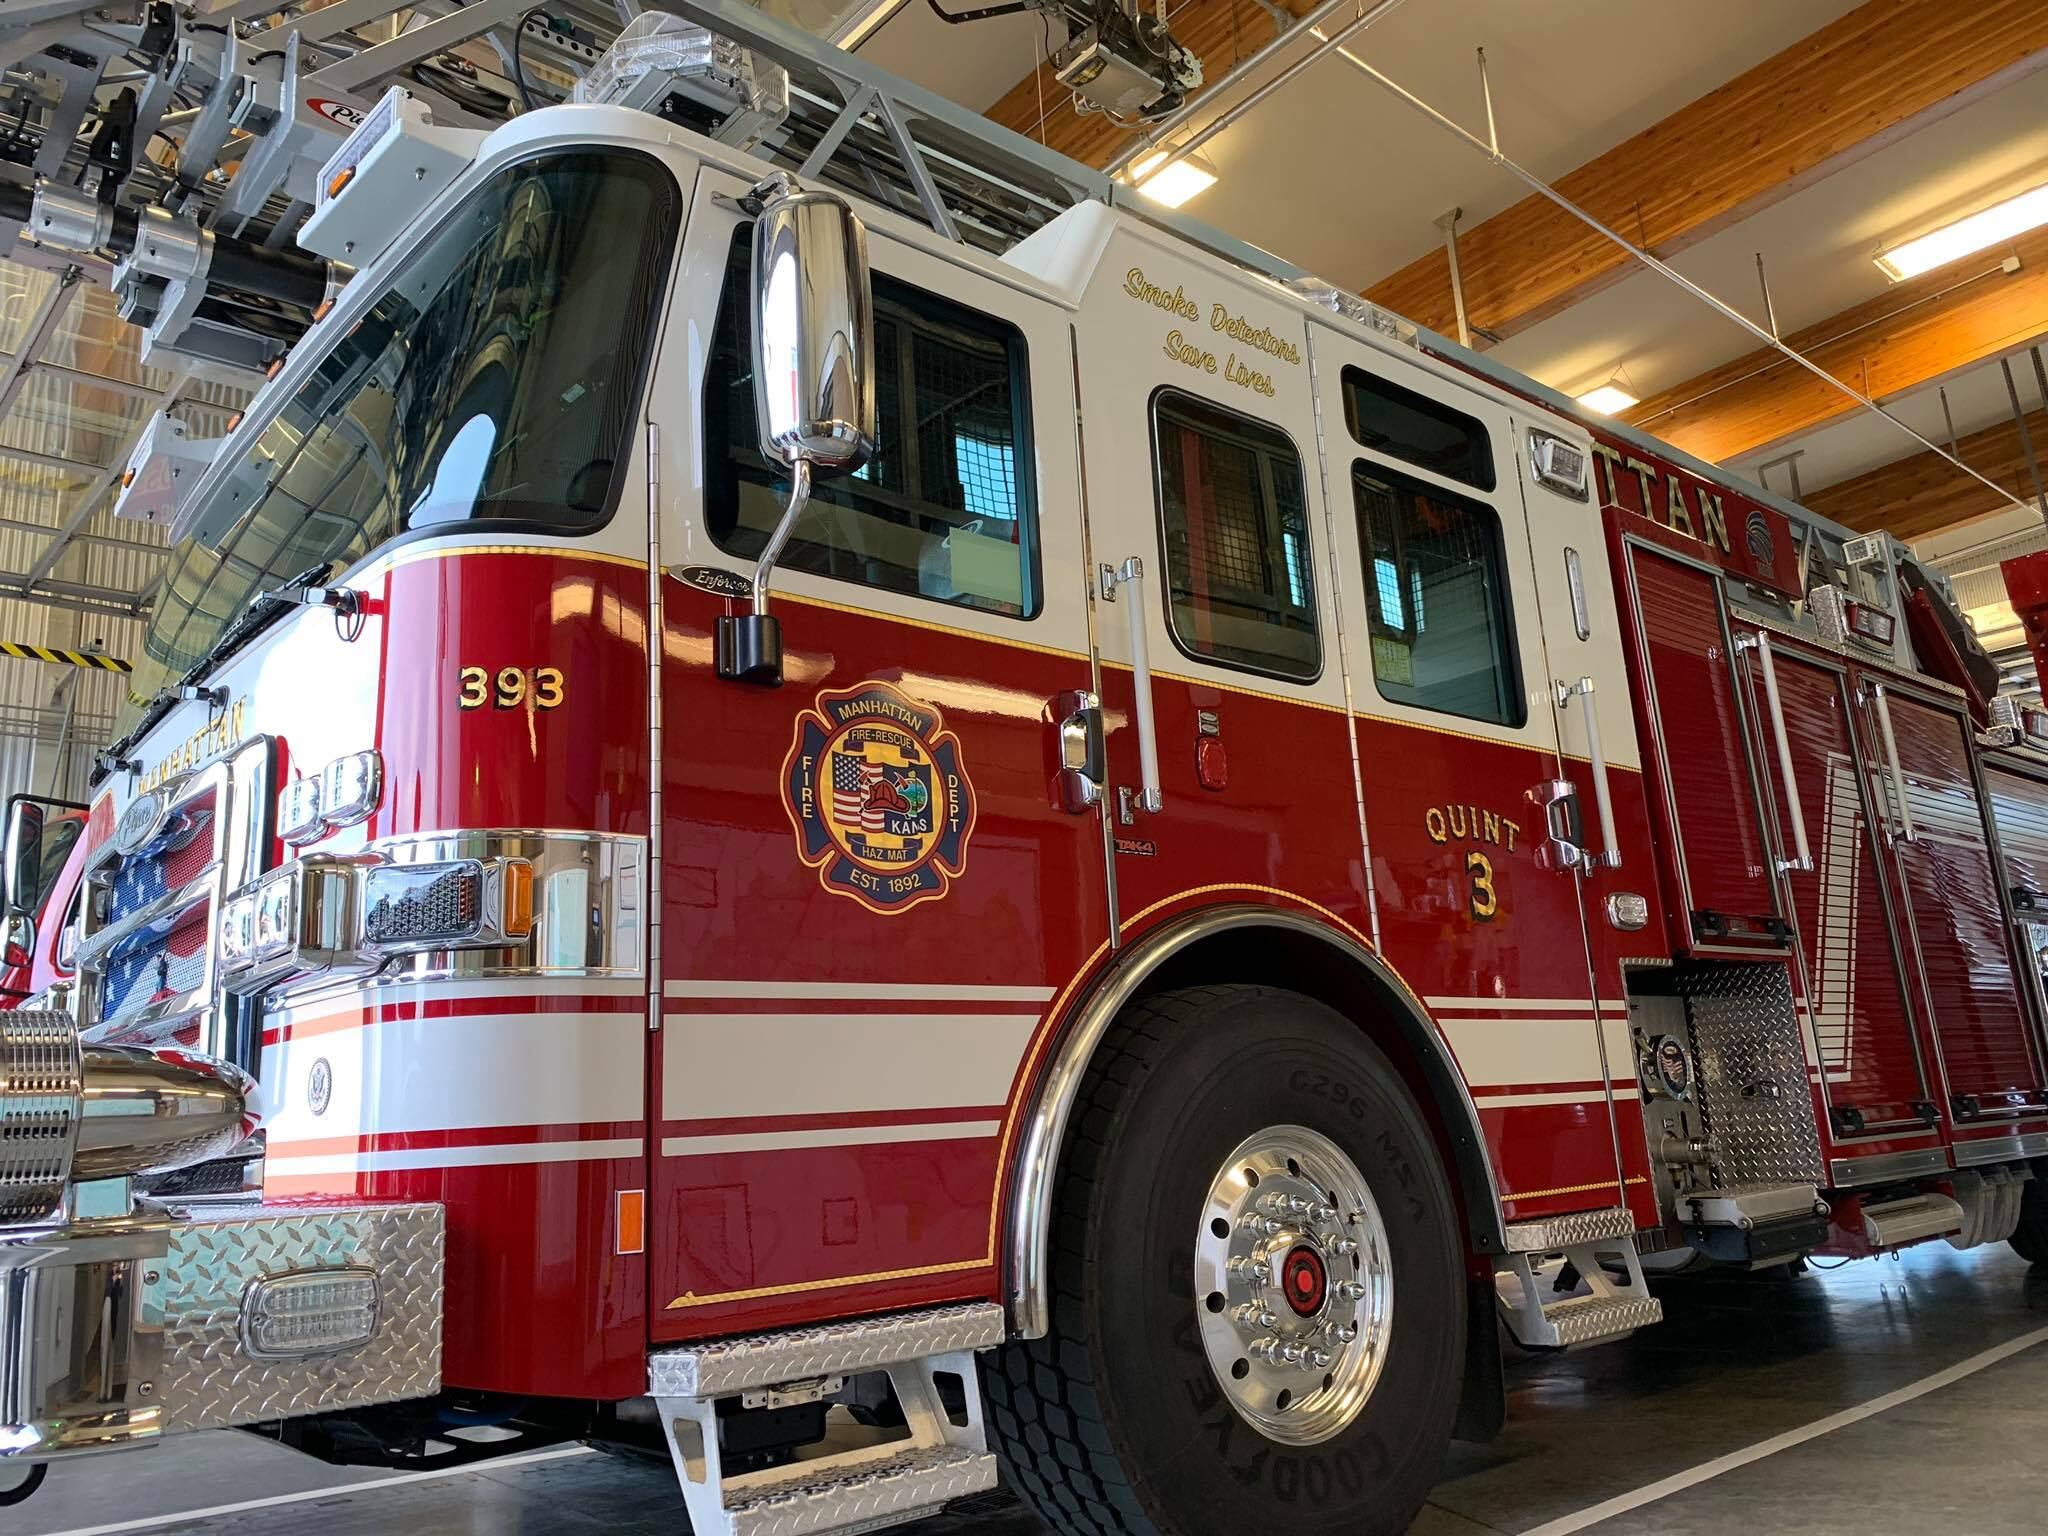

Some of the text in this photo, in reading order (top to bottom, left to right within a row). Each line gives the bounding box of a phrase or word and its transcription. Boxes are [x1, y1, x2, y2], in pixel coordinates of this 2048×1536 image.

[1123, 267, 1300, 365] Smoke Detectors
[1163, 329, 1275, 397] Save Lives
[1589, 441, 1731, 553] TTAN
[459, 666, 564, 710] 393
[838, 700, 923, 732] MANHATTAN
[138, 694, 247, 795] MANHATTAN
[851, 729, 913, 749] FIRE-RESCUE
[802, 756, 813, 818] FIRE
[948, 774, 960, 833] DEPT
[862, 846, 908, 861] HAZ MAT
[1426, 804, 1520, 853] QUINT
[850, 868, 922, 893] EST. 1892
[1466, 851, 1497, 918] 3
